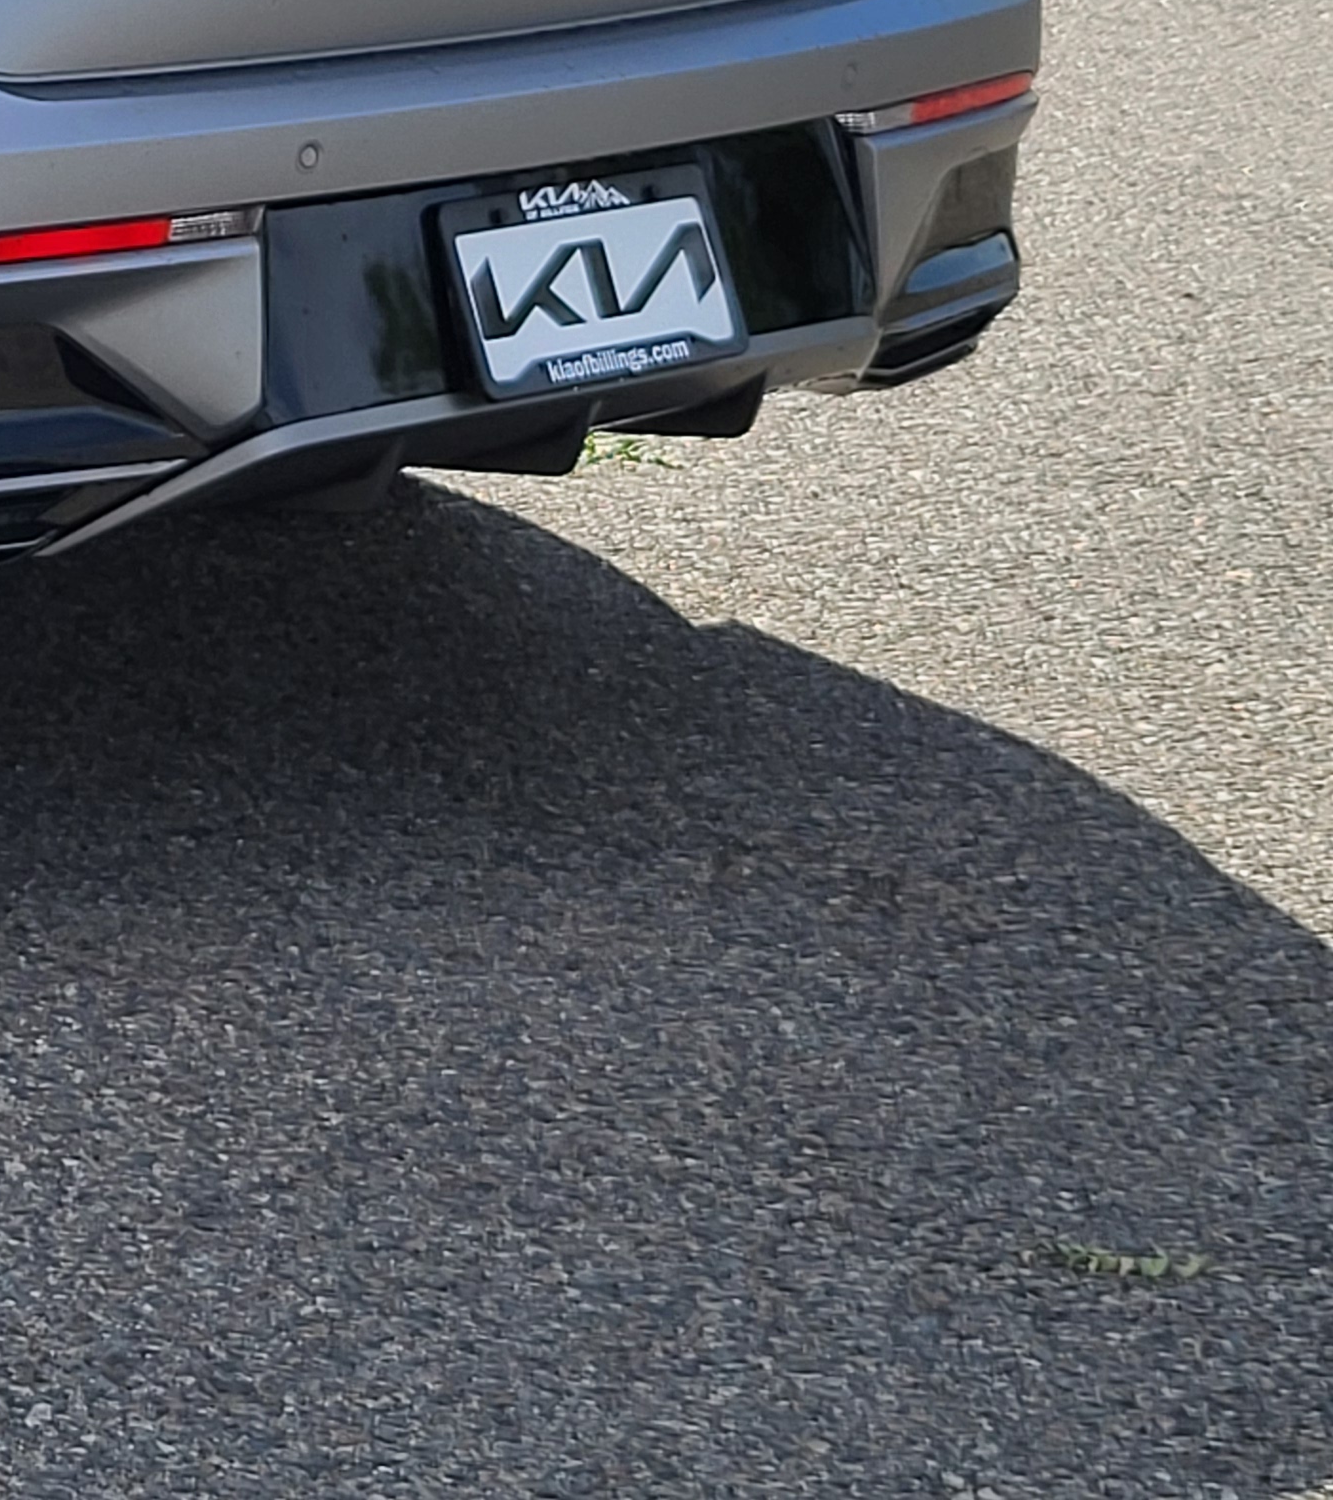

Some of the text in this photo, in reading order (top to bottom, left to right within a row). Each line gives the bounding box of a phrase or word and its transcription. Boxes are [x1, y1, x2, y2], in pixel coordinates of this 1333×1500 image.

[519, 182, 580, 212] KIA
[470, 220, 716, 340] KIA
[546, 340, 690, 383] kiaofbillings.com
